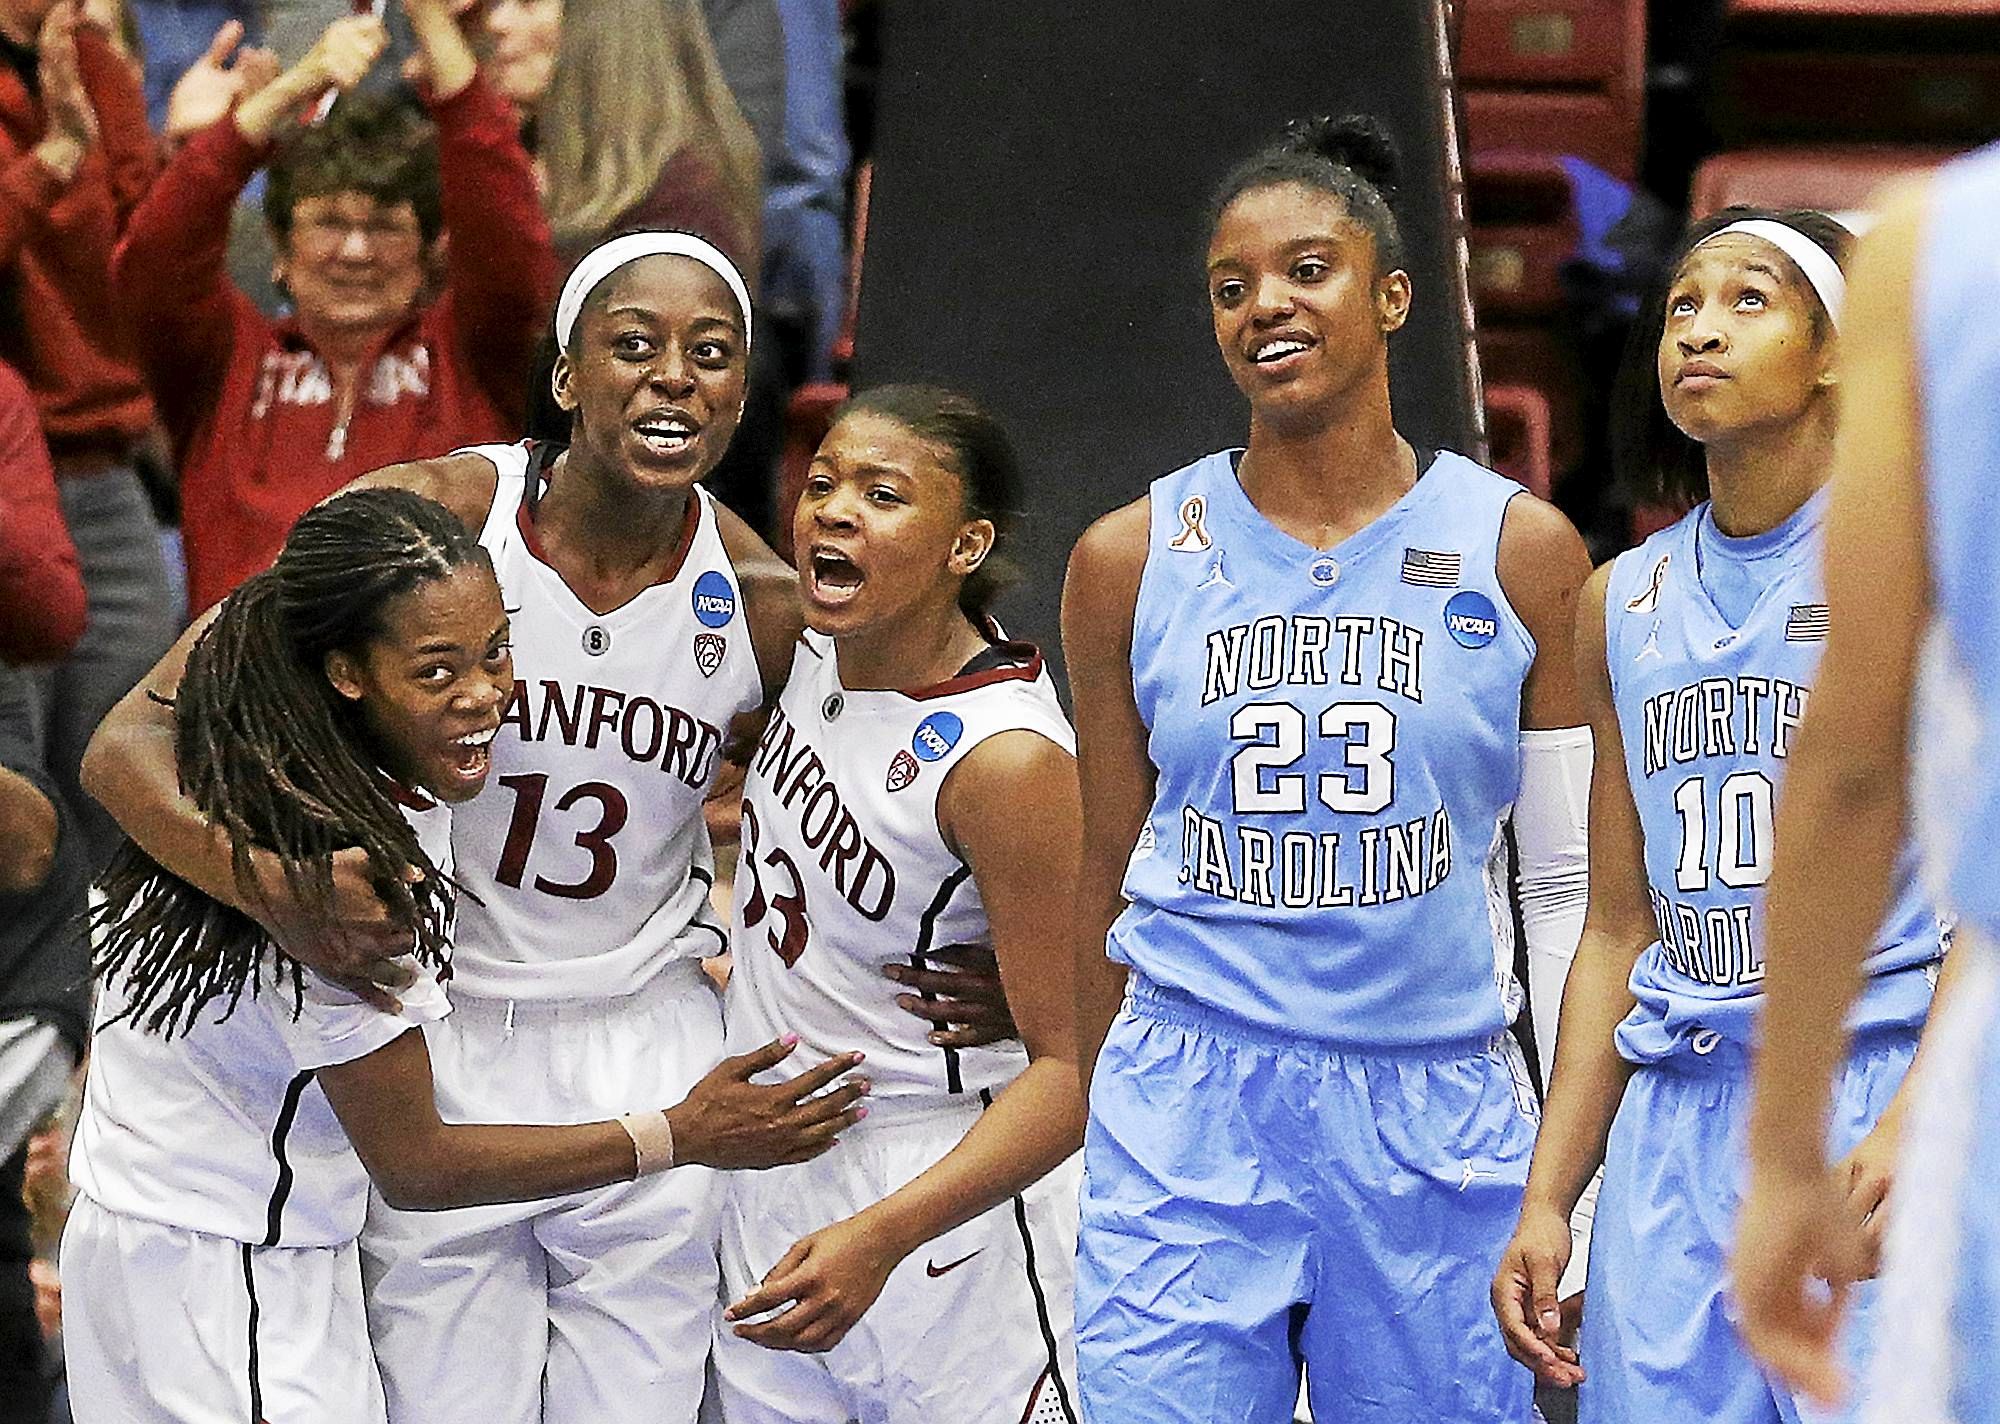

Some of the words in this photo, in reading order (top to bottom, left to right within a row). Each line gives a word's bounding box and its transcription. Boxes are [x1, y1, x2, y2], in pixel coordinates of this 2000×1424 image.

[697, 594, 734, 615] NCAA
[1449, 613, 1496, 637] NCAA
[1201, 614, 1425, 707] NORTH
[916, 723, 952, 759] NCAA
[1229, 701, 1397, 815] 23
[1643, 676, 1808, 778] NORTH
[494, 772, 628, 900] 13
[1177, 803, 1453, 909] CAROLINA
[1674, 771, 1774, 892] 10
